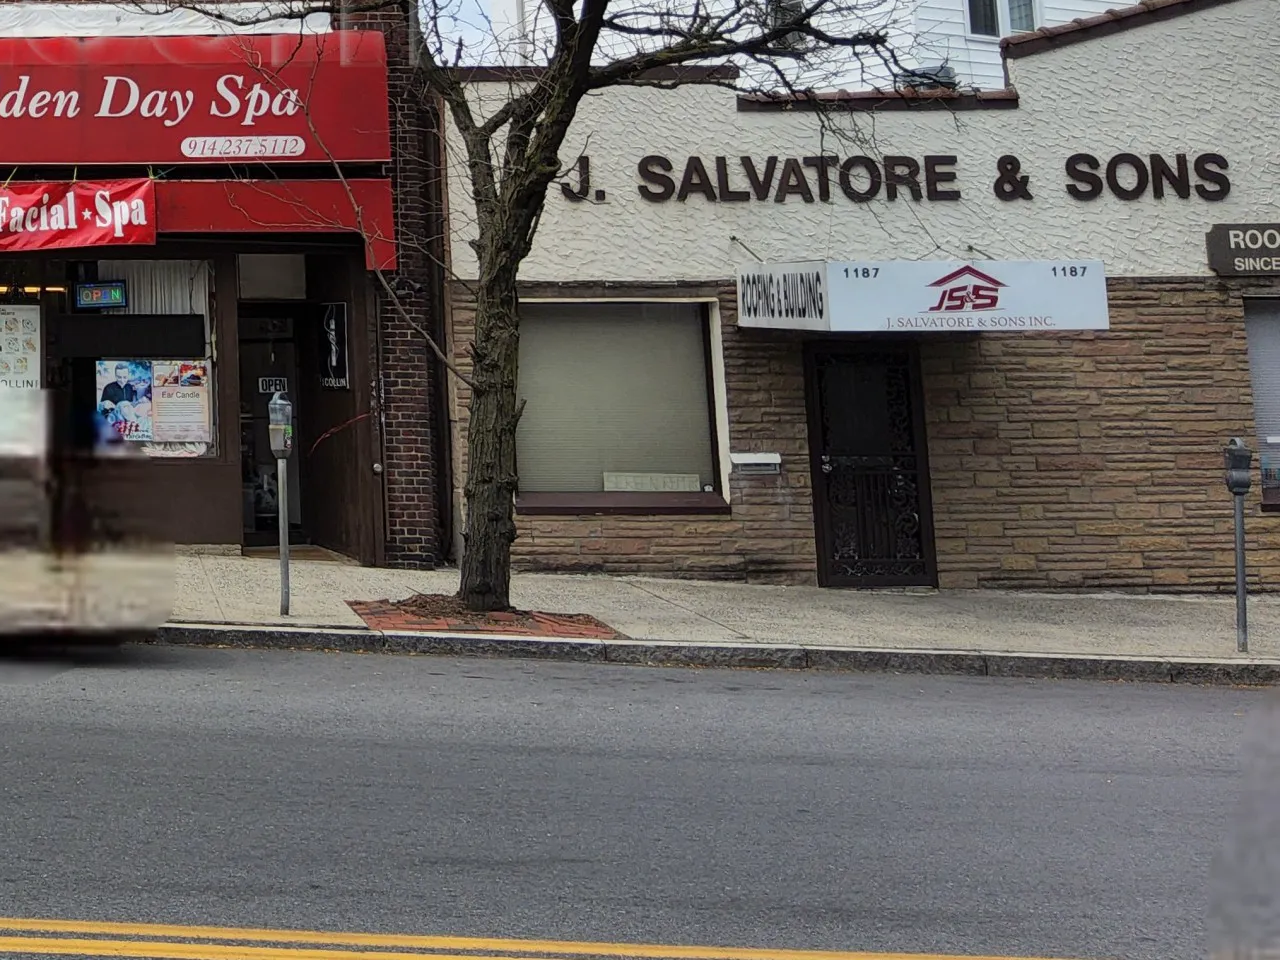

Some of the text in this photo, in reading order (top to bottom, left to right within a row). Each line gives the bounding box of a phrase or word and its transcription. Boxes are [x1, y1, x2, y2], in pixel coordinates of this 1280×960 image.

[94, 76, 194, 127] Day
[209, 74, 300, 126] Spa
[187, 138, 300, 156] 914.237.5112
[561, 152, 1231, 203] J. SALVATORE & SONS
[94, 190, 147, 238] Spa
[1234, 257, 1280, 271] SINCE
[843, 267, 880, 279] 1187
[1051, 266, 1088, 277] 1187
[82, 289, 120, 301] OPEN
[741, 271, 824, 319] ROOFING & BUILDING
[886, 315, 1056, 329] J. SALVATORE & SONS INC.
[261, 378, 286, 392] OPEN
[161, 391, 200, 399] Ear Candle
